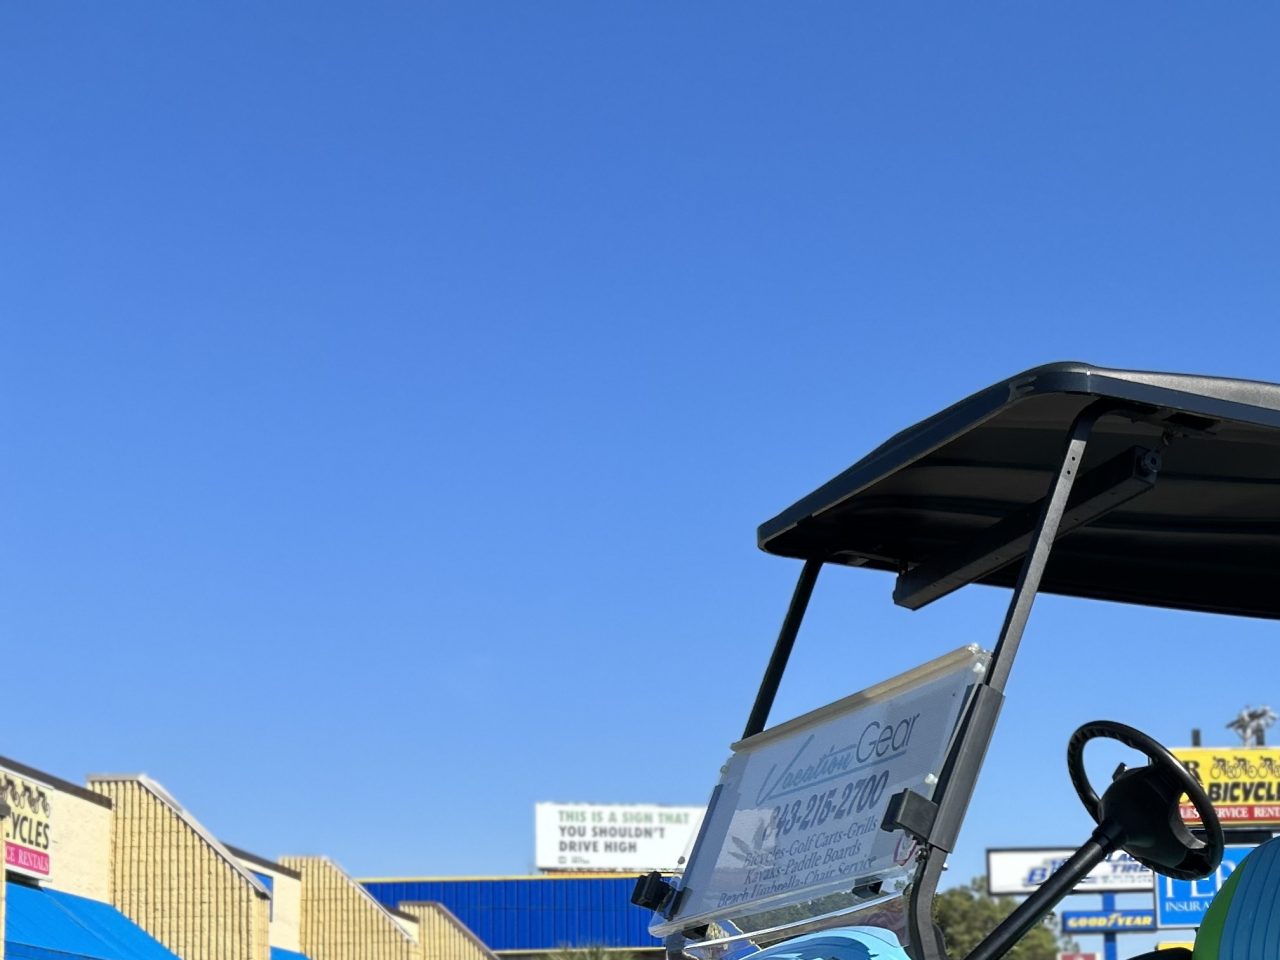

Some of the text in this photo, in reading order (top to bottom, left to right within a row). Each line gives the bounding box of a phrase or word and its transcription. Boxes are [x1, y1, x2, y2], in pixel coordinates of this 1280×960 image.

[856, 713, 921, 763] Gear
[558, 810, 690, 824] THIS IS A SIGN THAT
[6, 812, 50, 850] YCLES
[558, 826, 666, 839] YOU SHOULDN'T
[559, 841, 637, 853] DRIVE HIGH
[824, 839, 862, 864] Boards
[1067, 912, 1153, 929] GOODYEAR
